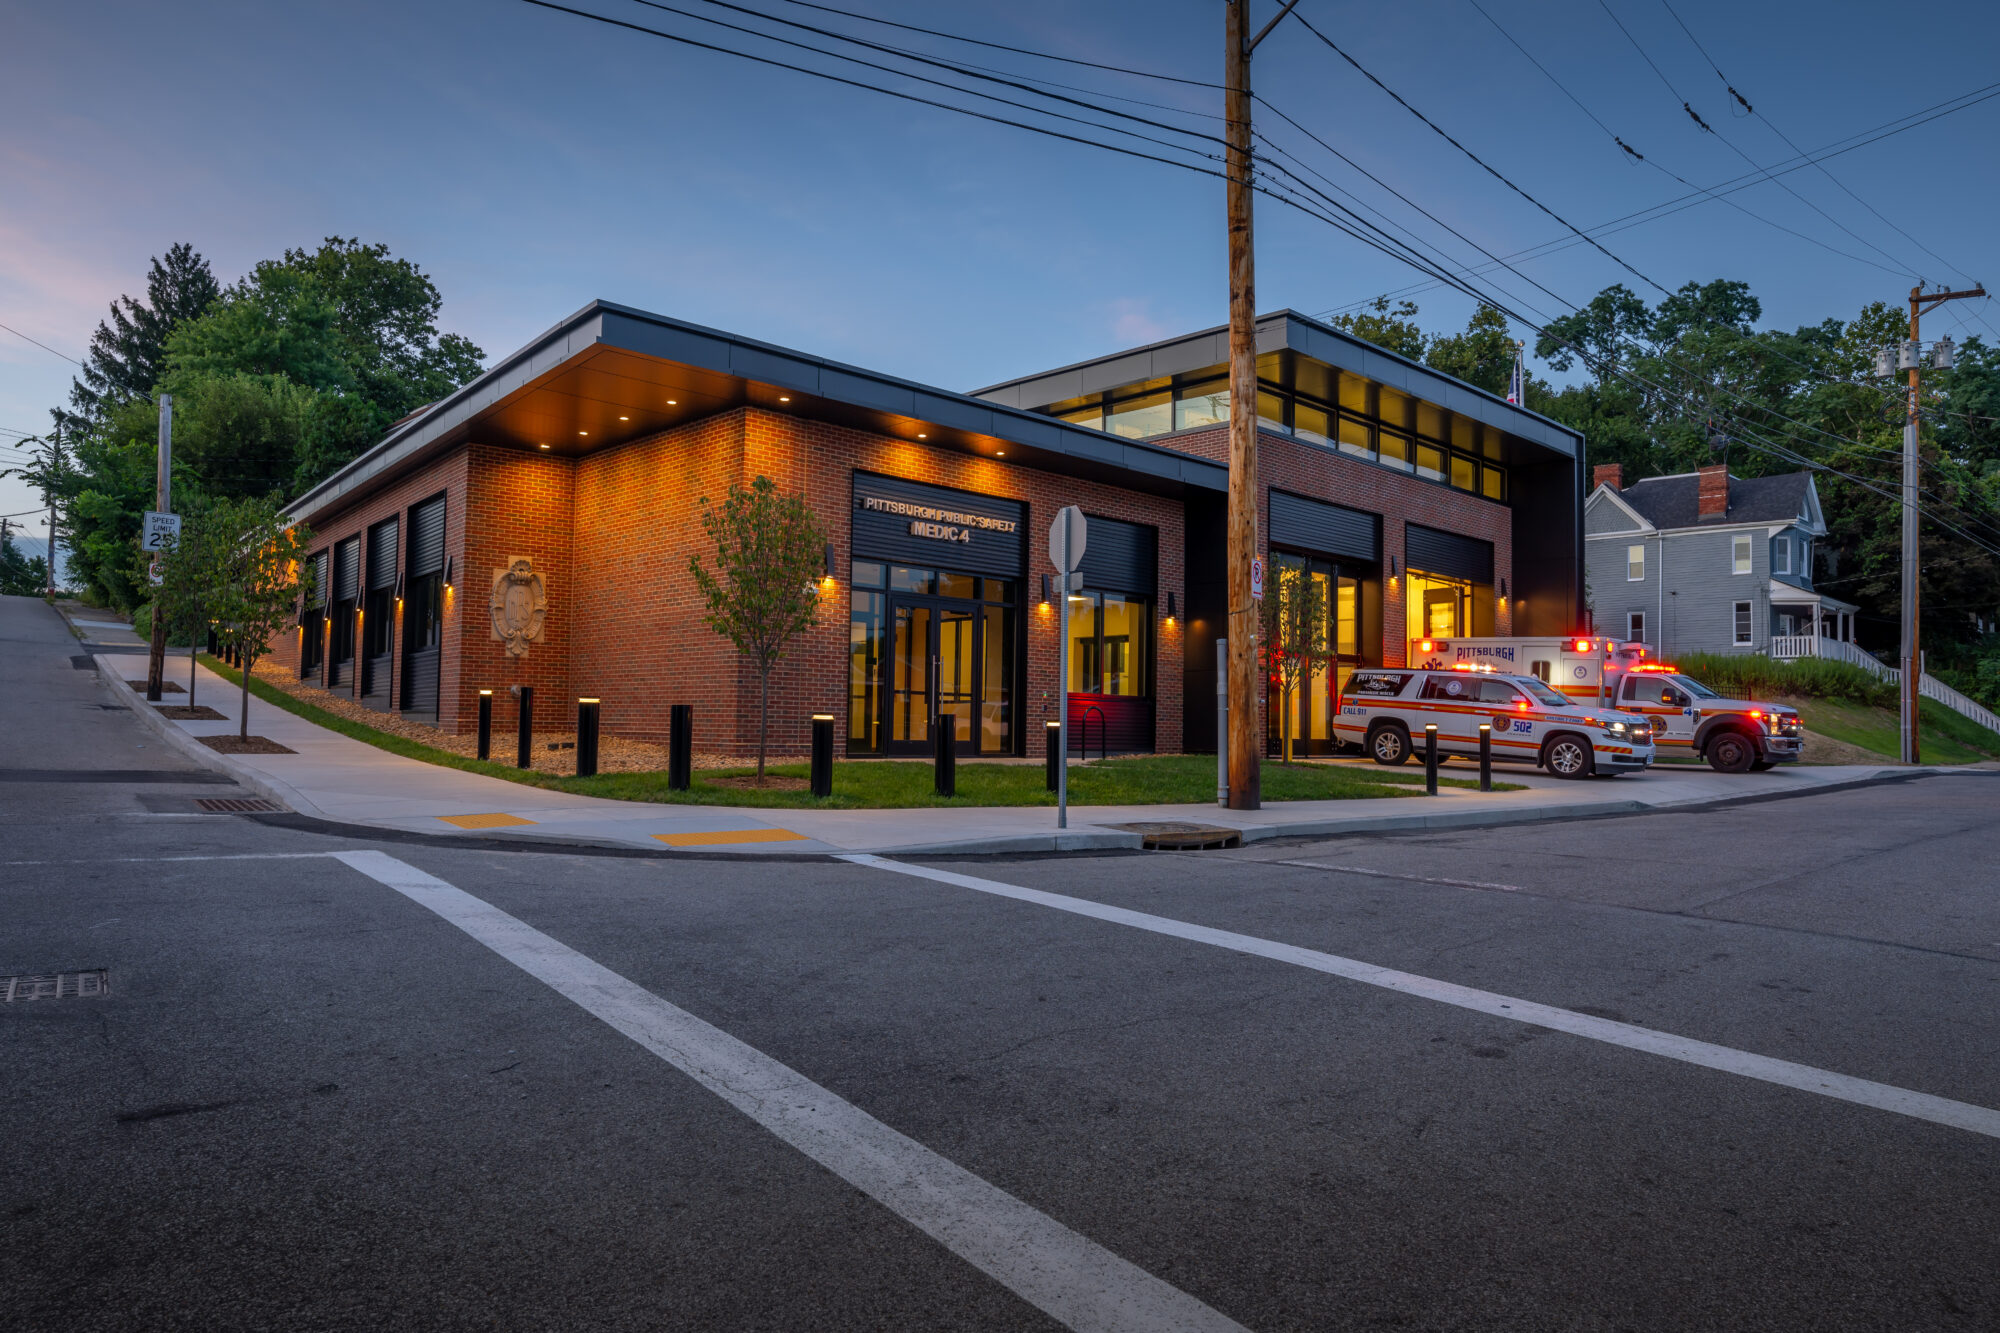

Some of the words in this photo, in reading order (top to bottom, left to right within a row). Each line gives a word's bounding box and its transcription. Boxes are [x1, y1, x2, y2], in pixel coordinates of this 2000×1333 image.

[865, 498, 936, 519] PITTSBURGH
[937, 510, 977, 526] PUBLIC
[977, 517, 1017, 533] SAFETY
[911, 521, 959, 541] MEDIC
[959, 529, 970, 543] 4
[150, 533, 173, 547] 25
[1457, 647, 1515, 662] PITTSBURGH
[1357, 673, 1401, 684] PITTSBURGH
[1343, 707, 1356, 715] CALL
[1684, 708, 1692, 716] 4
[1514, 721, 1532, 733] 502
